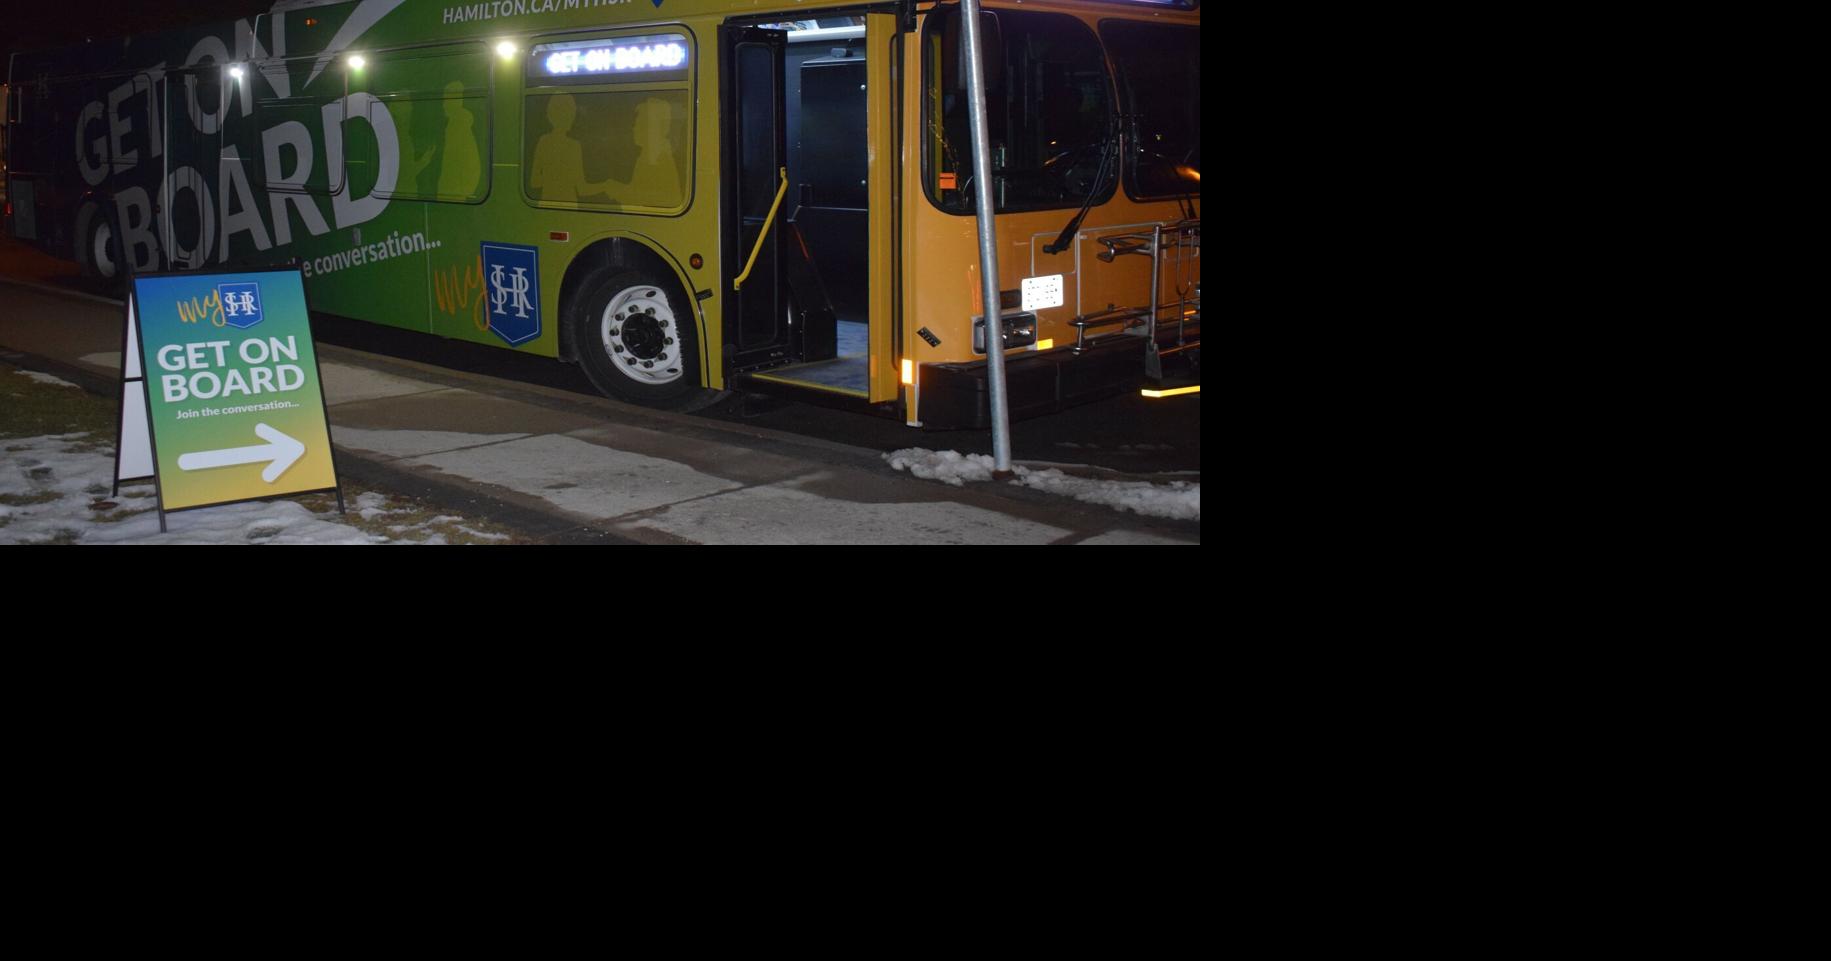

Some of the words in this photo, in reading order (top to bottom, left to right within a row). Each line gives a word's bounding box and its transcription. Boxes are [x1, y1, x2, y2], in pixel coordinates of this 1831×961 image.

[443, 0, 632, 24] HAMILTON.CA/M
[548, 51, 580, 73] GET
[585, 49, 610, 71] ON
[615, 43, 681, 69] BOARD
[75, 62, 166, 186] GET
[184, 17, 291, 135] ON
[113, 91, 400, 273] BOARD
[157, 340, 231, 371] GET
[239, 335, 298, 364] ON
[161, 364, 305, 403] BOARD
[176, 410, 200, 420] Join
[201, 408, 221, 417] the
